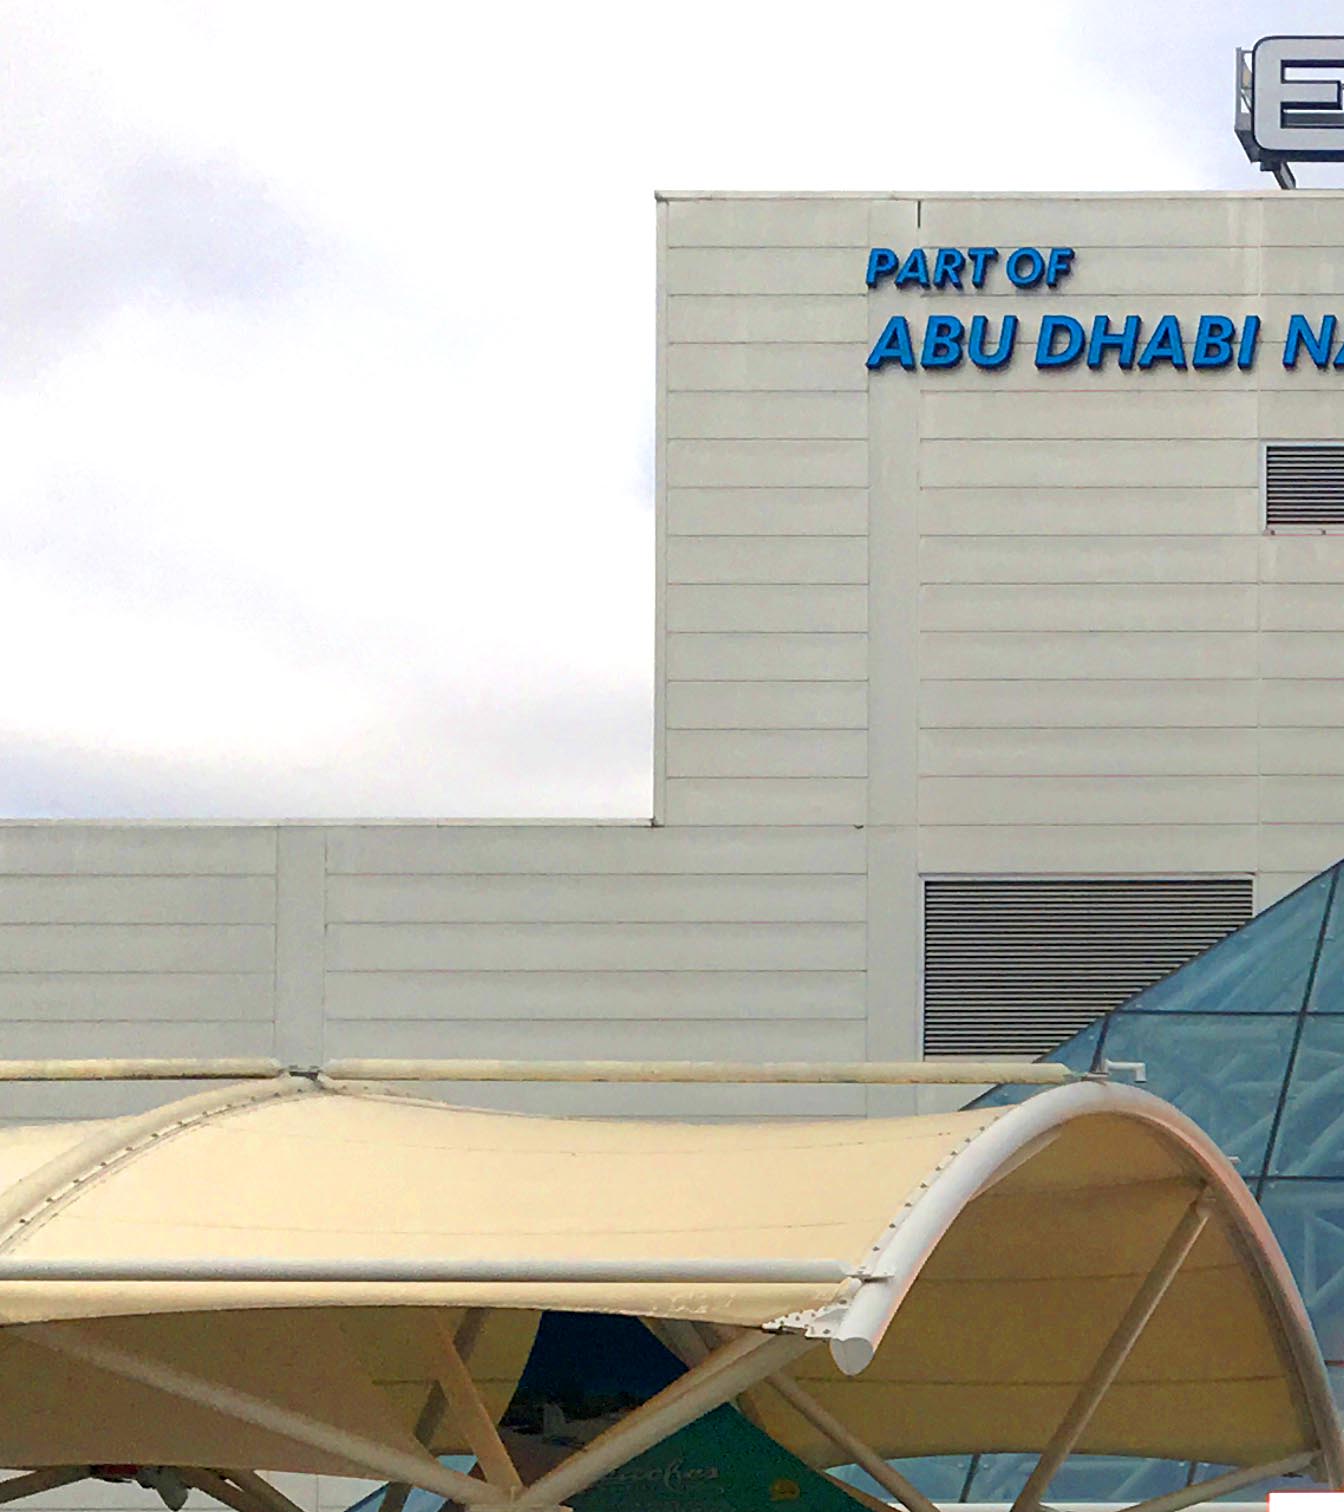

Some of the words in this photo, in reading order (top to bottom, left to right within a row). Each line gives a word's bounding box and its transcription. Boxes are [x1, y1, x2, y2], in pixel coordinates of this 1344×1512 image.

[865, 247, 997, 289] PART
[1005, 247, 1075, 289] OF
[865, 314, 1017, 371] ABU
[1033, 314, 1262, 370] DHABI
